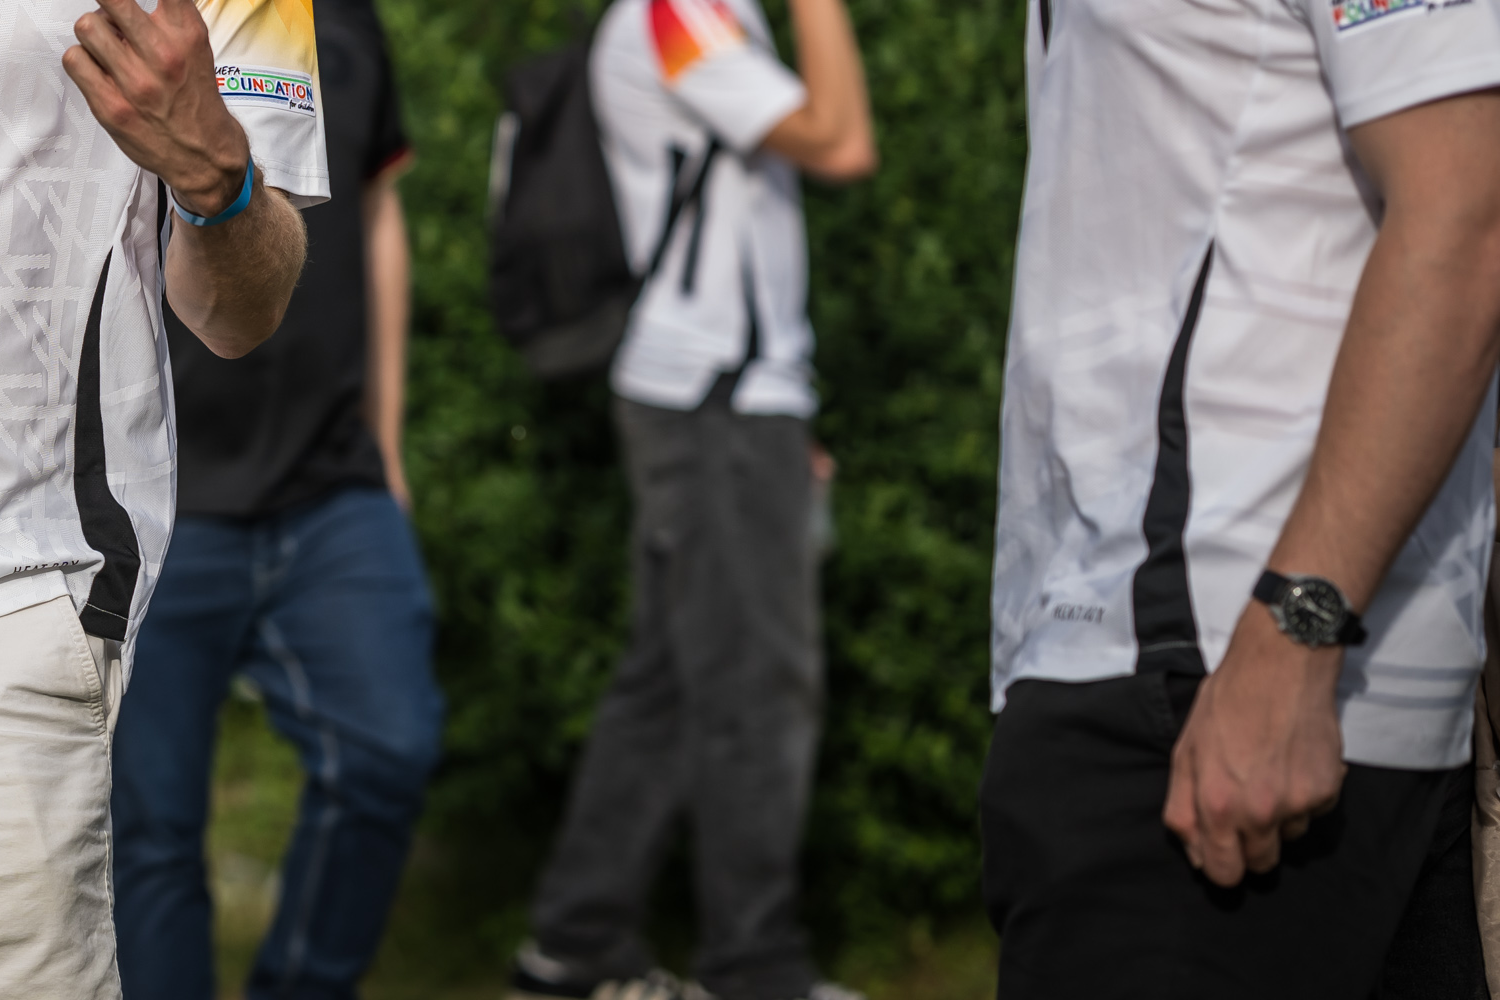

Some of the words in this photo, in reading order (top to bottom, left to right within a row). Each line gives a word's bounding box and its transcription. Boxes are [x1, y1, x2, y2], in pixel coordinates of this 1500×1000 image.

[214, 65, 241, 77] UEFA
[216, 77, 314, 102] FOUNDATION
[289, 100, 297, 109] for
